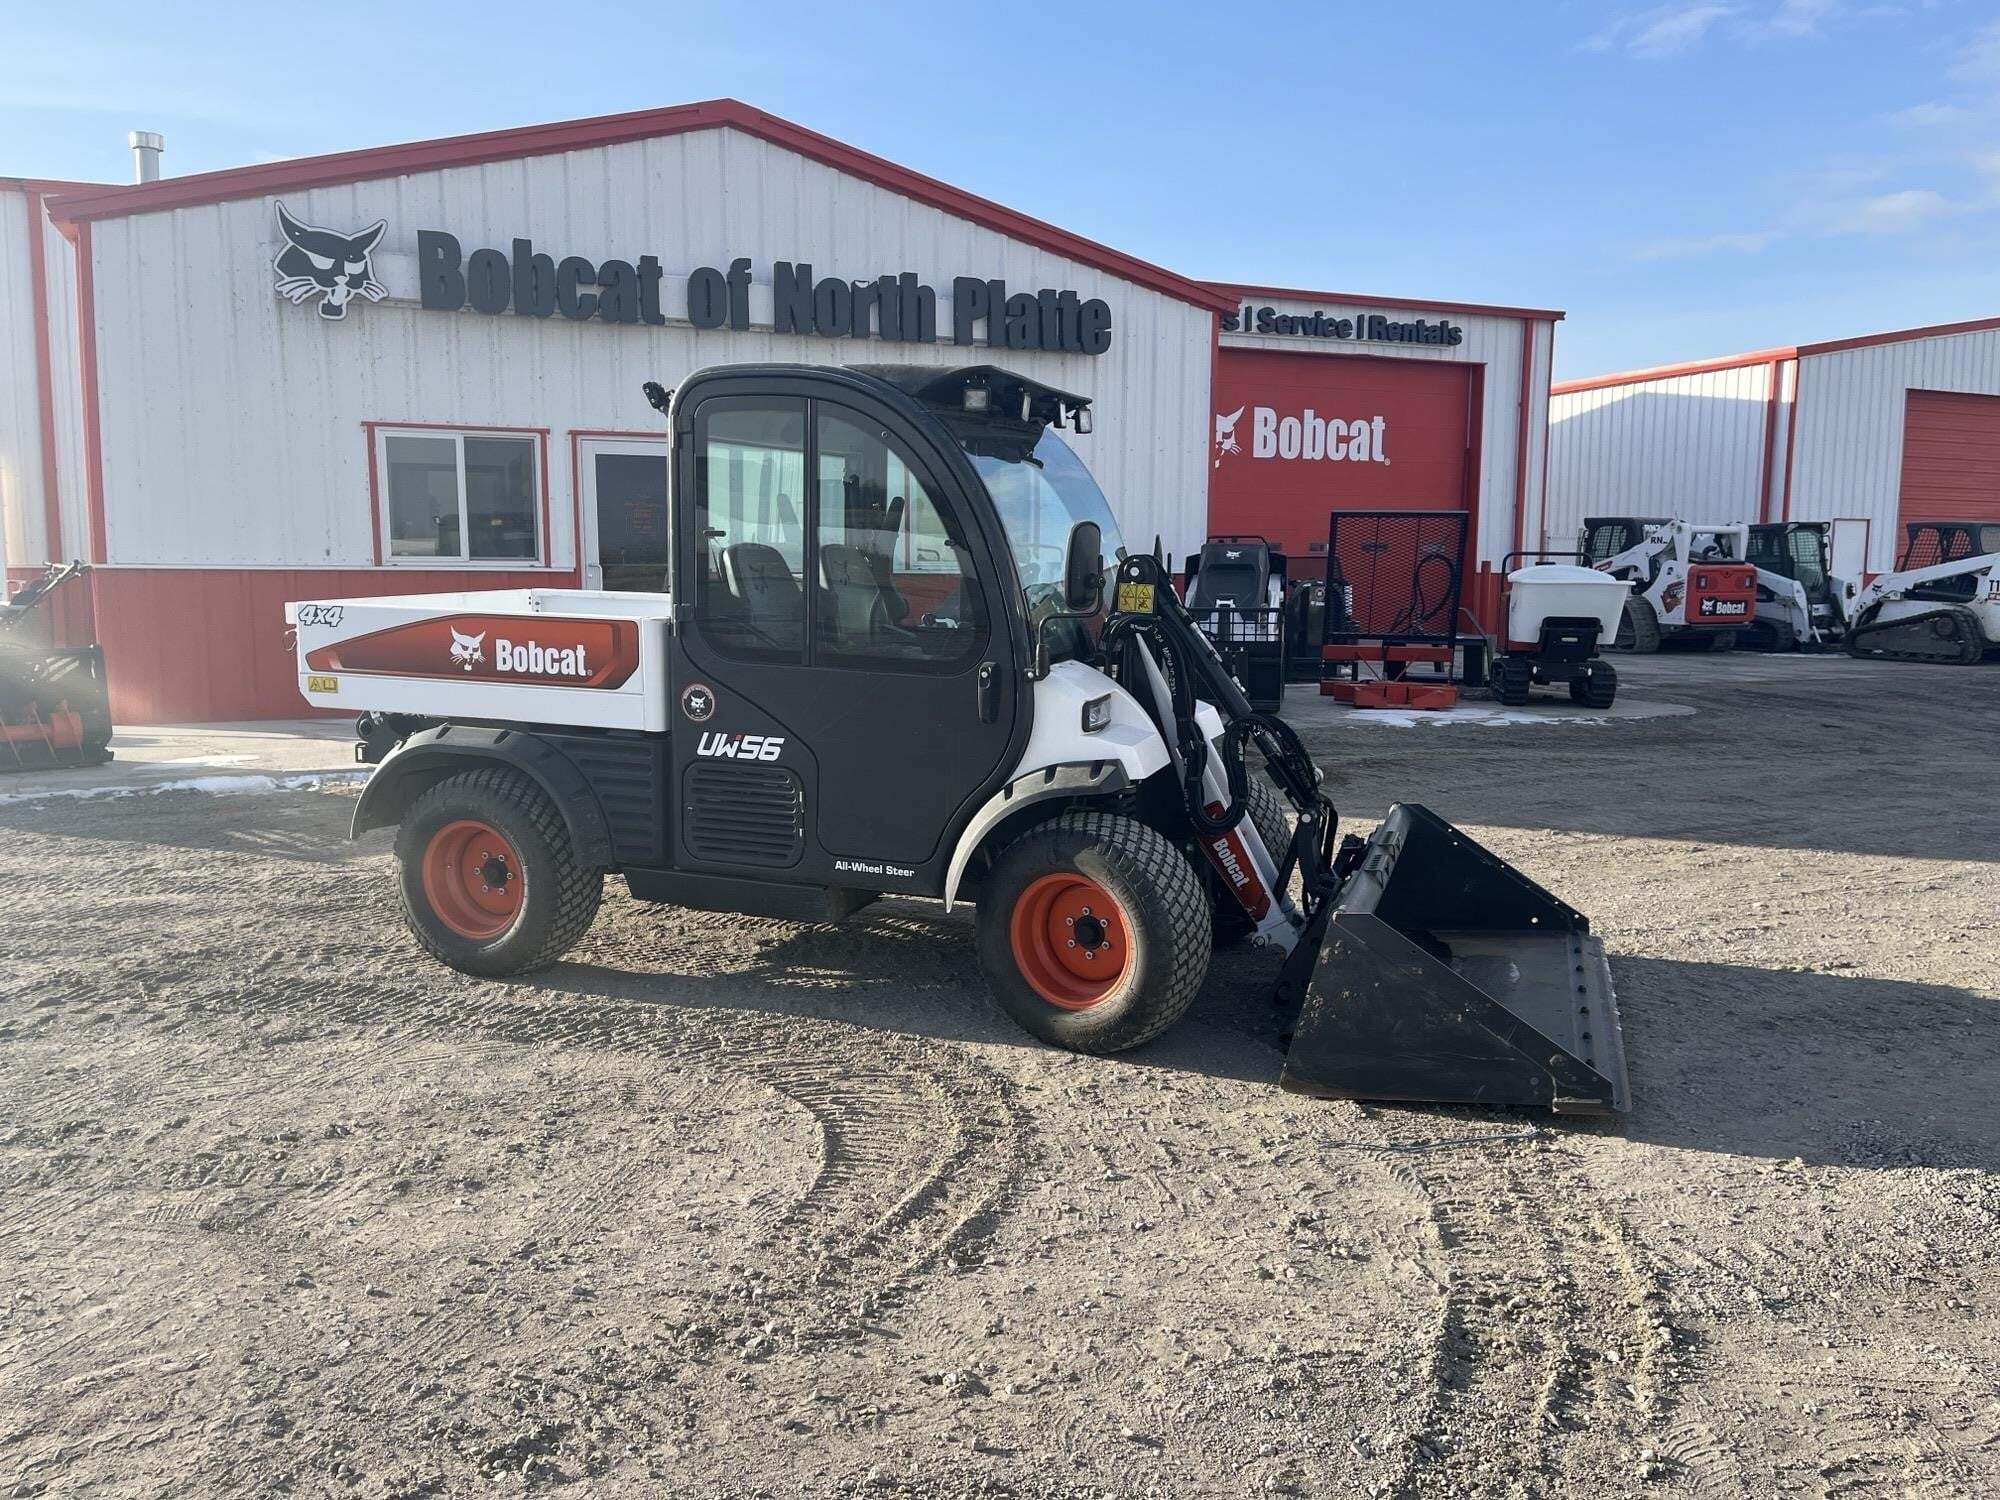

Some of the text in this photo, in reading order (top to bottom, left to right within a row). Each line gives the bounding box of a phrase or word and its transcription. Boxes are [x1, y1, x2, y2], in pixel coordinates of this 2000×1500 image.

[417, 229, 1112, 355] Bobcat of North Platte
[1257, 306, 1353, 339] Service
[1368, 314, 1463, 346] Rentals
[1253, 406, 1386, 462] Bobcat
[298, 604, 344, 627] 4x4
[1716, 601, 1745, 614] Bobcat
[496, 638, 587, 676] Bobcat
[697, 731, 785, 761] UW56
[835, 861, 915, 877] All-Wheel Steer
[1212, 838, 1250, 888] Bobcat
